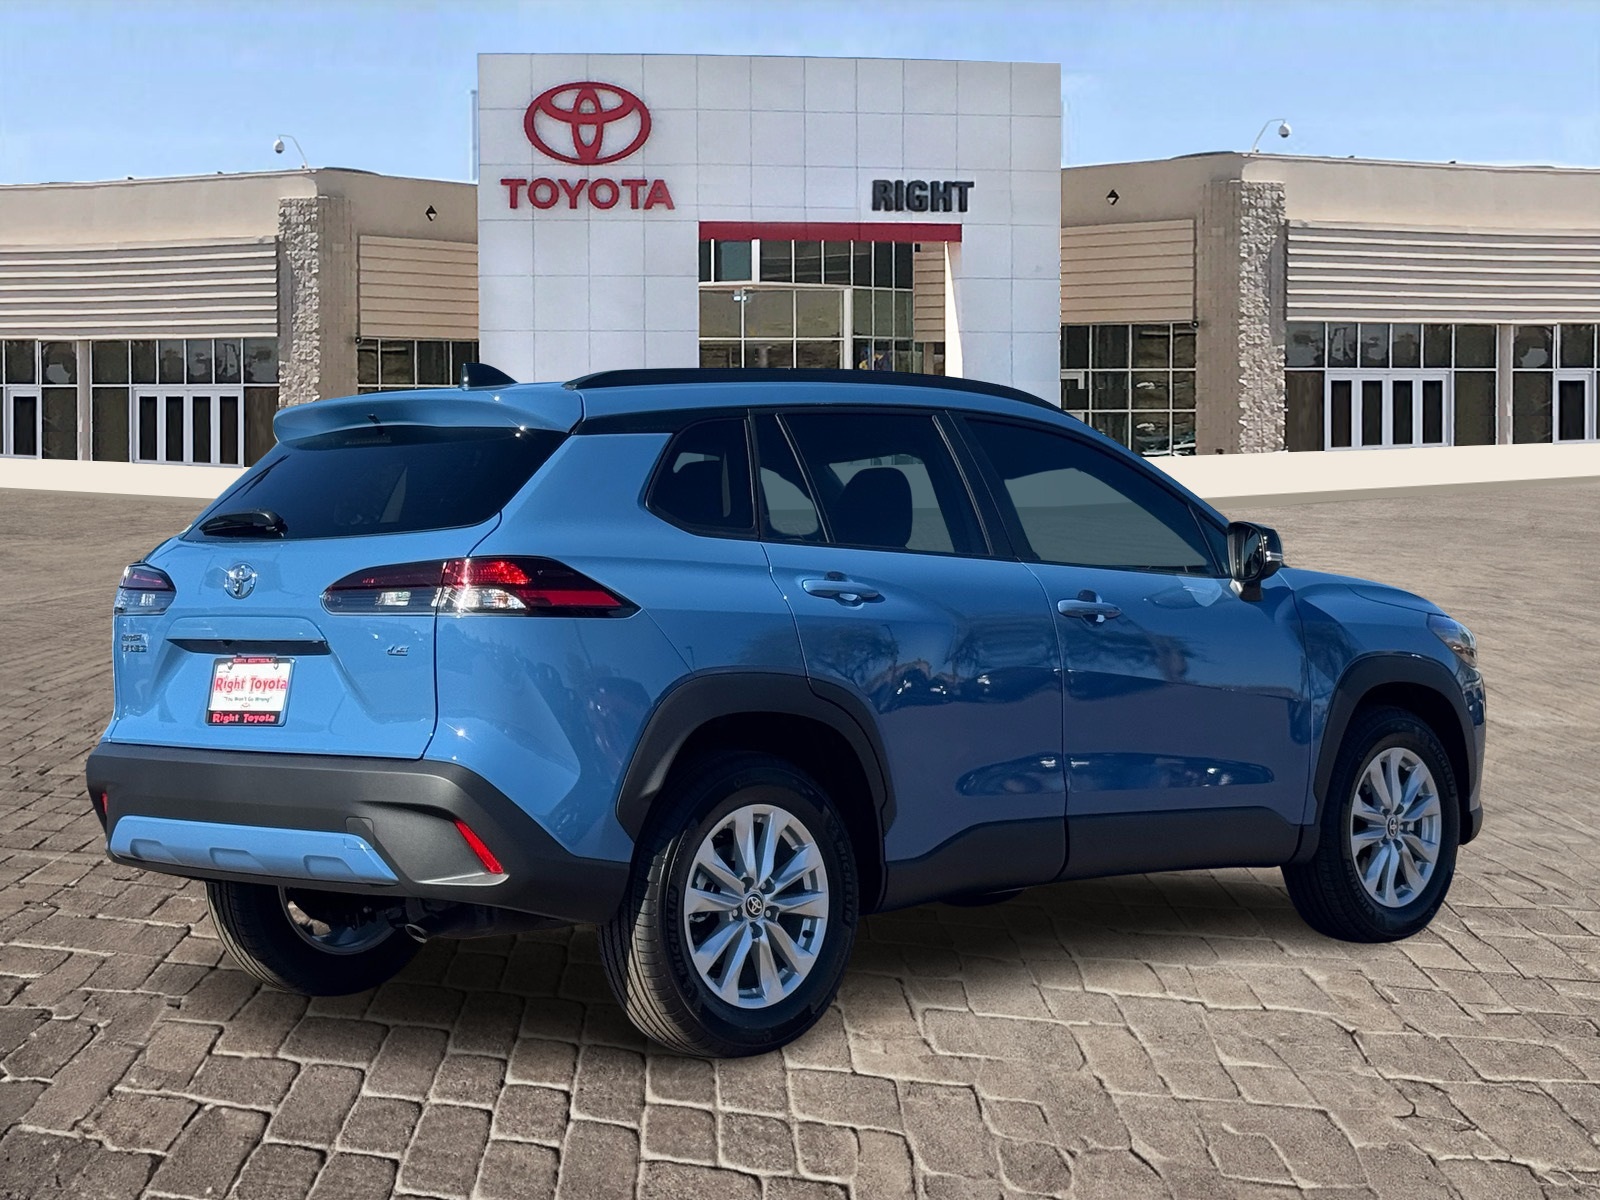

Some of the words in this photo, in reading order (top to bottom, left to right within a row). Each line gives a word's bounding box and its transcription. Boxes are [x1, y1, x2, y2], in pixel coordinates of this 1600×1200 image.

[500, 177, 675, 210] TOYOTA
[872, 179, 975, 212] RIGHT
[214, 677, 246, 693] Right
[250, 677, 288, 692] Toyota
[212, 712, 239, 723] Right
[243, 713, 275, 723] Toyota
[834, 840, 854, 924] MICHELIN
[667, 886, 689, 979] MICHELIN
